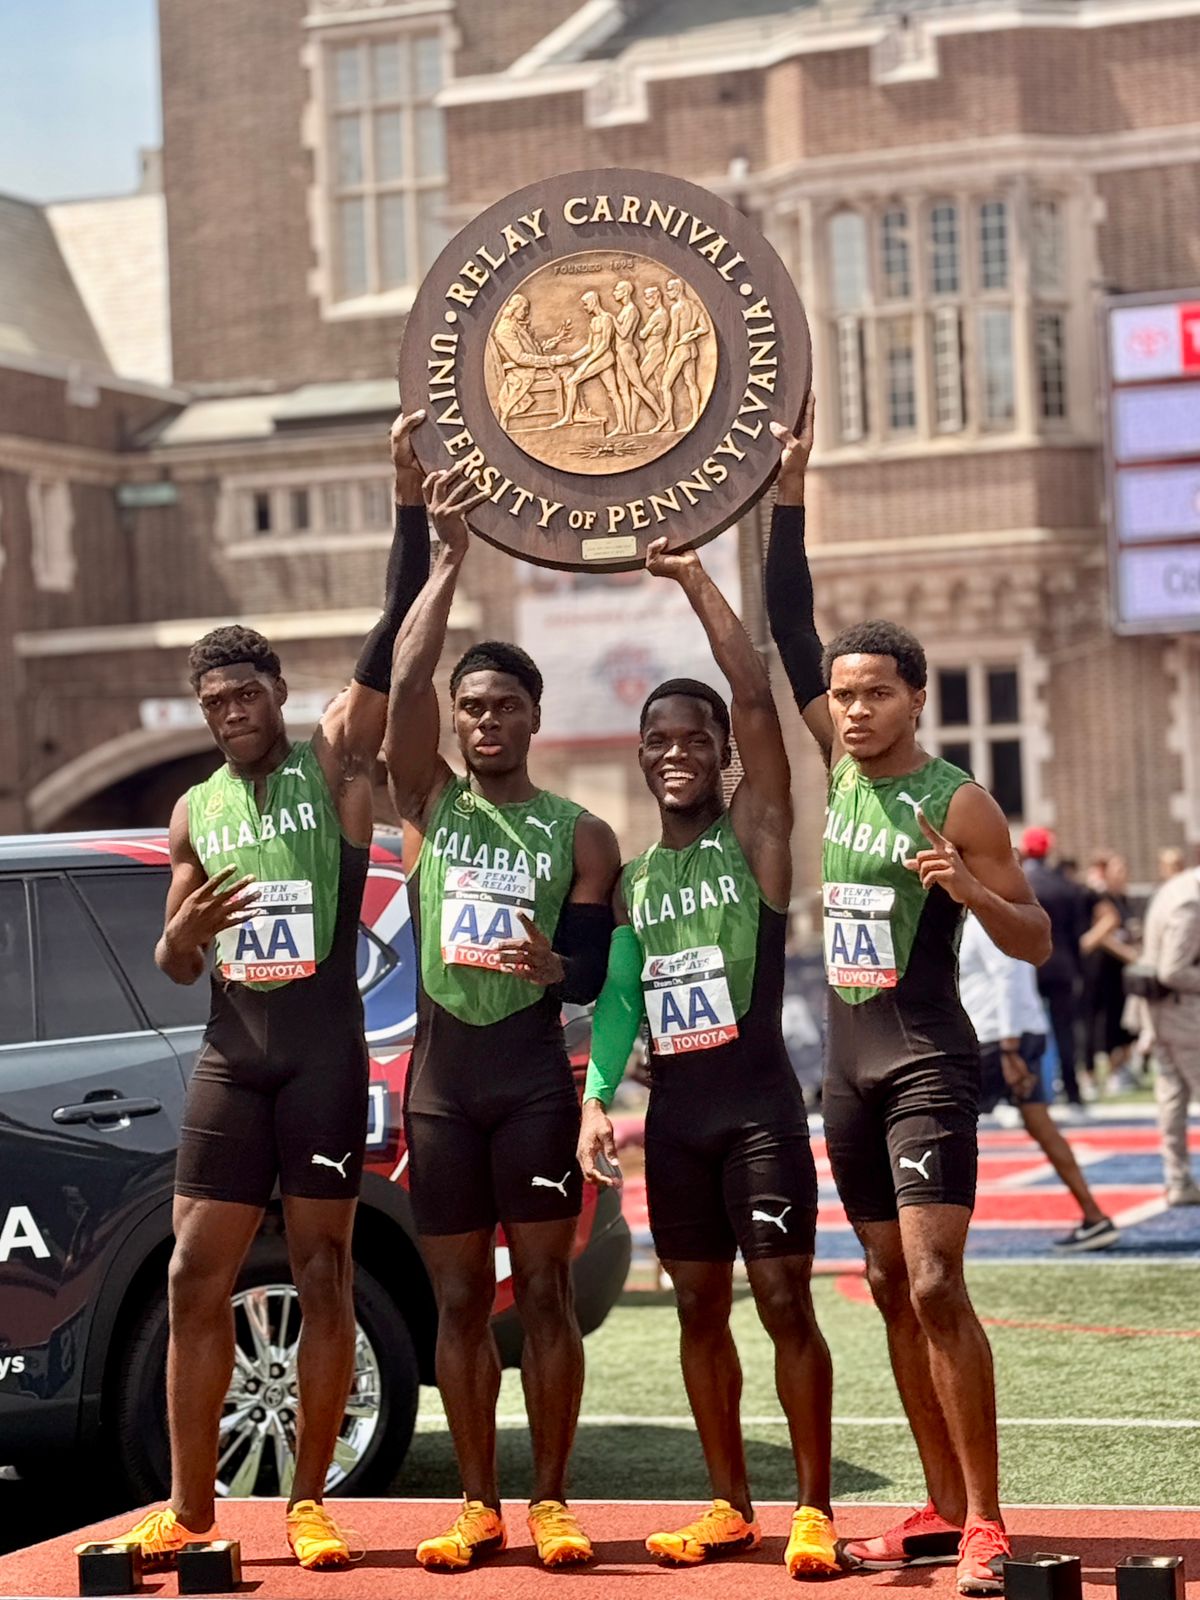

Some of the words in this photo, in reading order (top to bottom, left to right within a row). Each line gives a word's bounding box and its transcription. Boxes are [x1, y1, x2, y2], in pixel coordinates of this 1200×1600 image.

[445, 208, 547, 309] RELAY
[563, 194, 746, 283] CARNIVAL
[553, 262, 603, 276] FOUNDED
[427, 333, 563, 529] UNIVERSITY
[568, 509, 598, 531] OF
[607, 296, 778, 534] PENNSYLVANIA
[196, 802, 317, 865] CALABAR
[823, 805, 910, 864] ALABAR
[432, 826, 552, 882] CALABAR
[481, 881, 527, 894] RELAYS
[484, 872, 518, 882] PENN
[843, 887, 873, 896] PENN
[257, 893, 298, 903] ELAYS
[628, 875, 740, 934] ALABAR
[842, 897, 874, 907] RELAY
[235, 919, 300, 960] AA
[448, 904, 513, 945] AA
[458, 948, 501, 965] TOYO
[830, 922, 881, 966] AA
[247, 965, 306, 978] TOYOTA
[838, 970, 889, 985] TOYOTA
[661, 986, 721, 1034] AA
[673, 1030, 729, 1050] TOYOTA
